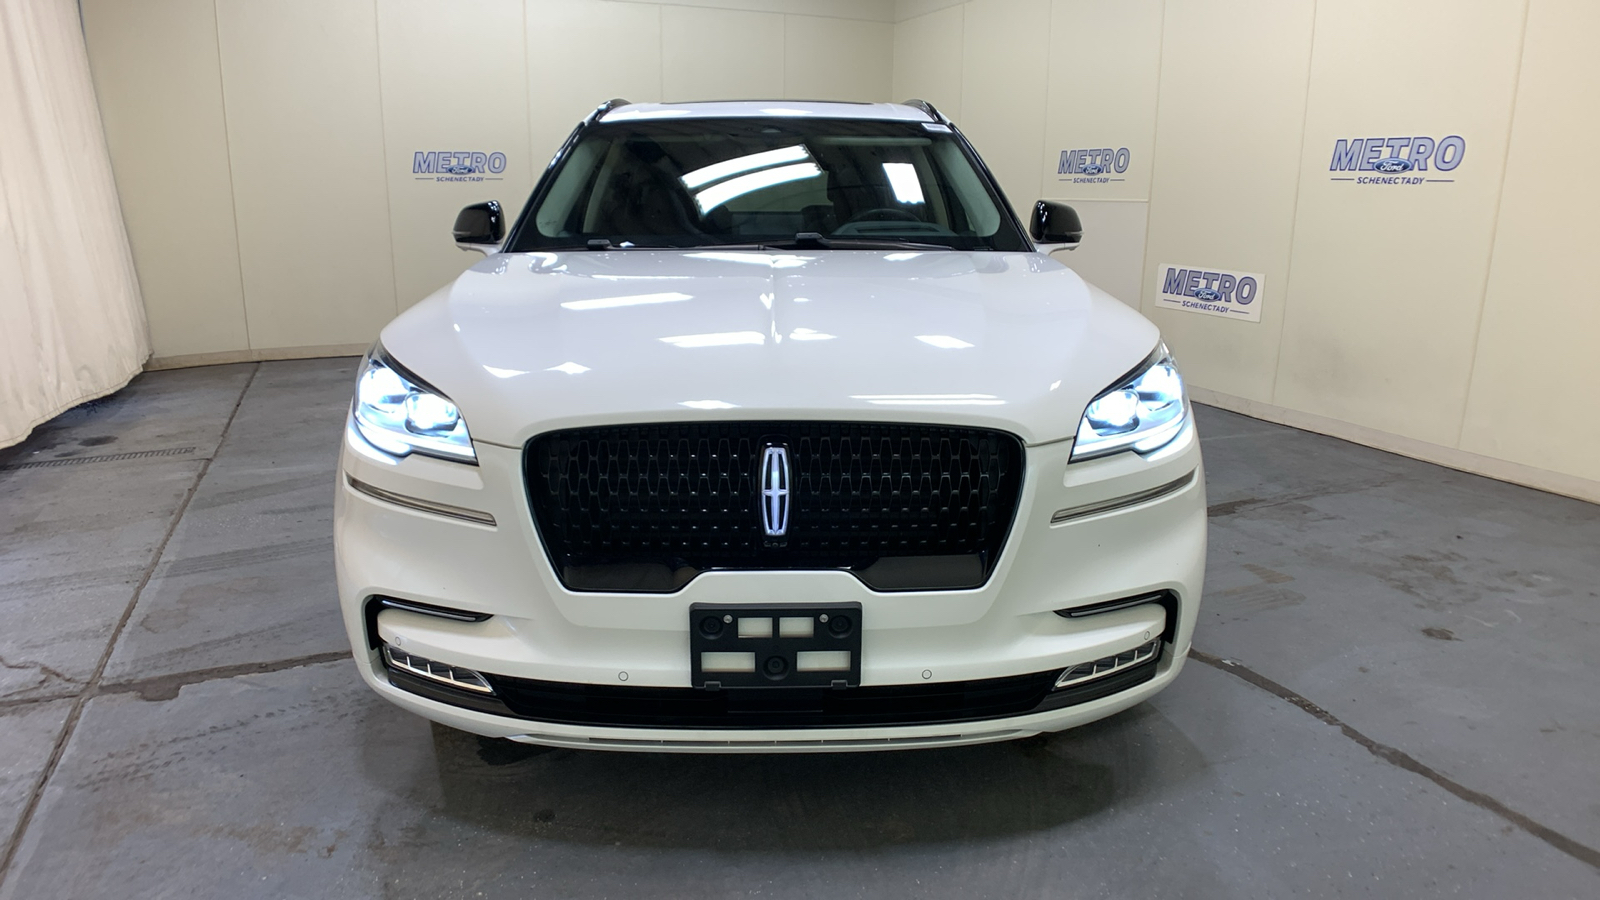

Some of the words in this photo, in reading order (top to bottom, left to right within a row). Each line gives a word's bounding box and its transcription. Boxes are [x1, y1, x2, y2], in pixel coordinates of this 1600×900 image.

[412, 151, 507, 174] METRO
[1057, 147, 1131, 174] METRO
[1329, 135, 1466, 171] METRO
[1357, 177, 1425, 185] SCHENECTADY
[1162, 267, 1258, 305] METRO
[1181, 300, 1230, 313] SCHENECTADY
